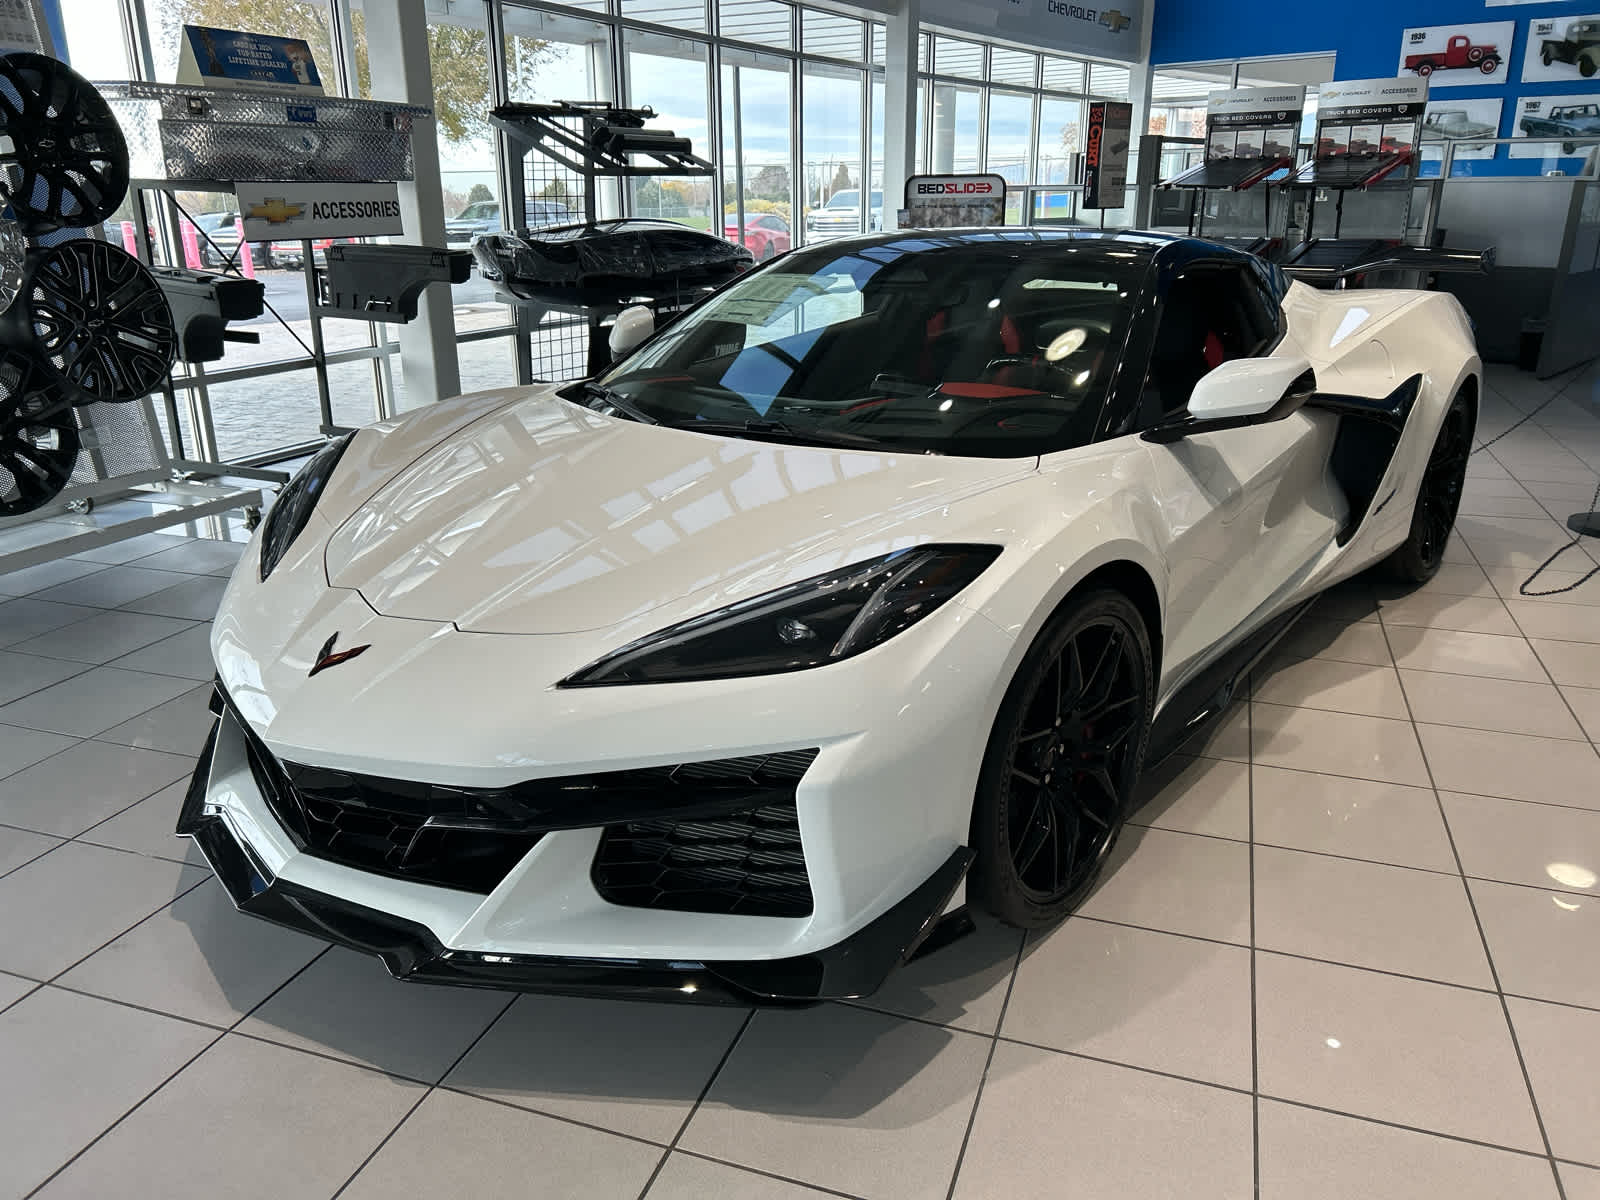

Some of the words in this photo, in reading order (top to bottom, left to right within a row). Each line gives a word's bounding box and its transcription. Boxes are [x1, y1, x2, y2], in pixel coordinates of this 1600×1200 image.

[1048, 0, 1097, 22] CHEVROLET
[1381, 87, 1418, 95] ACCESSORIES
[312, 200, 400, 220] ACCESSORIES
